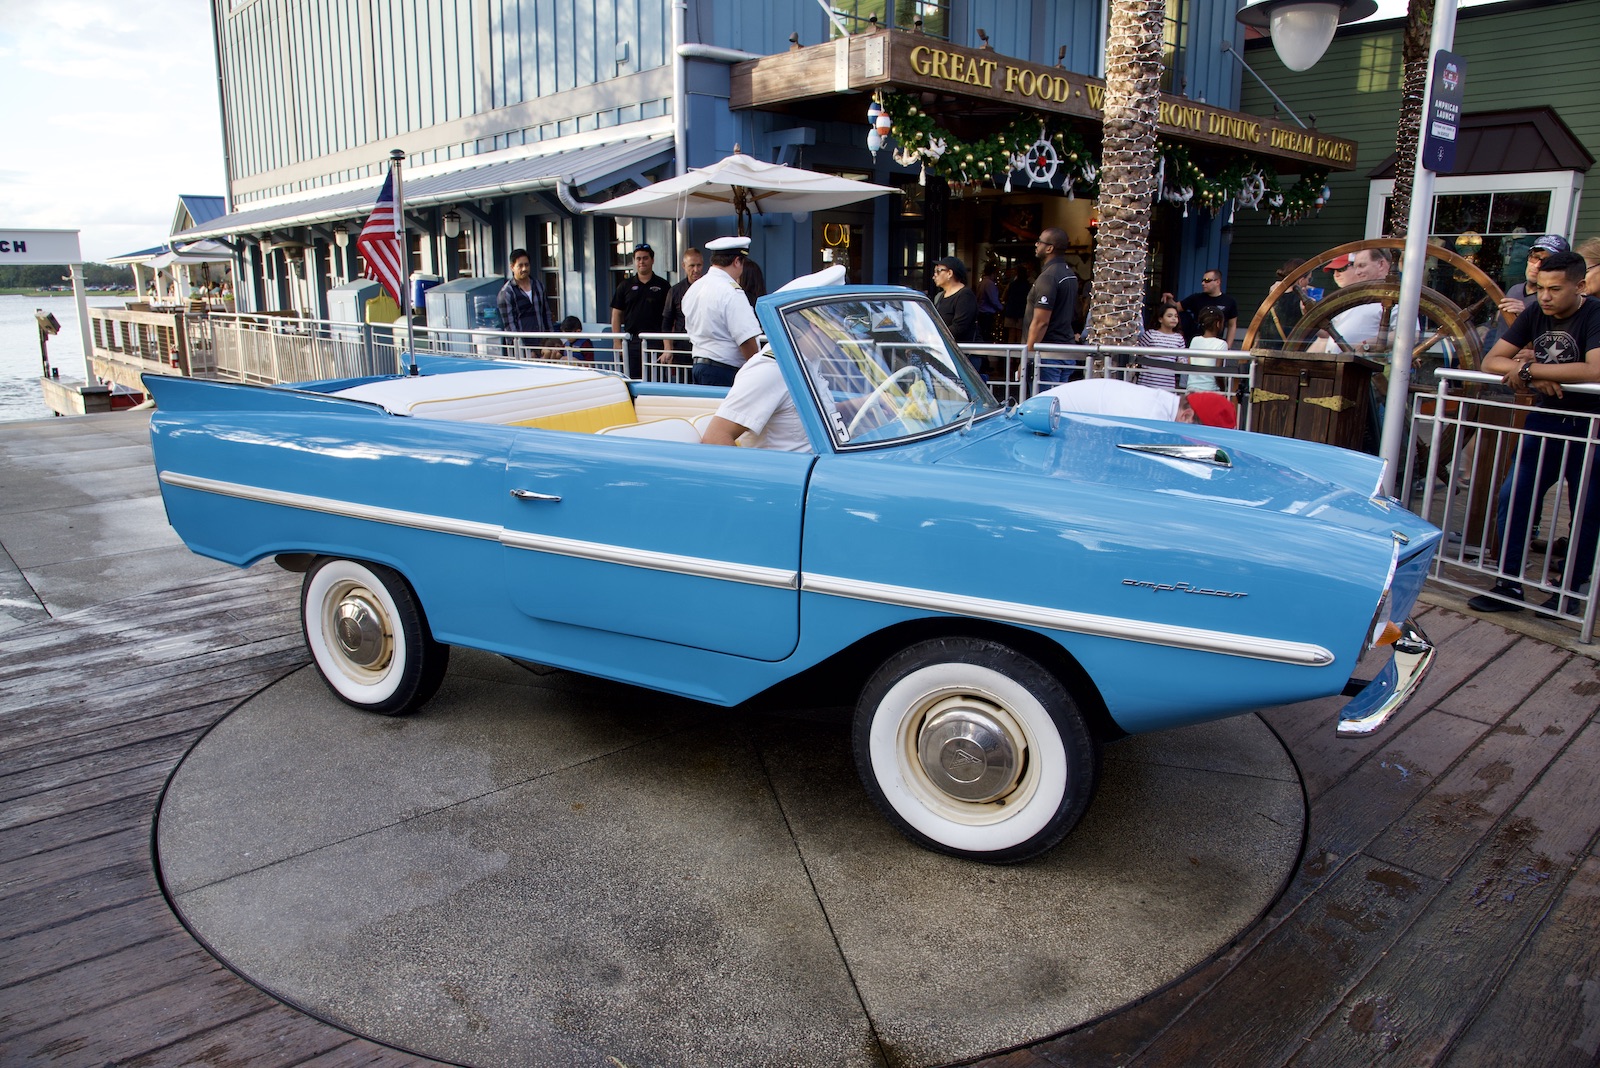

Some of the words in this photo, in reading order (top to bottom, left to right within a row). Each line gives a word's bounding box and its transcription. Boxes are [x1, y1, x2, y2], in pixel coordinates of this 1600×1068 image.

[910, 45, 998, 89] GREAT
[1005, 65, 1070, 103] FOOD
[1208, 112, 1262, 144] DINING
[1270, 127, 1315, 155] DREAM
[1316, 138, 1353, 163] BOATS
[1435, 99, 1459, 113] AMPHICAR
[1436, 109, 1456, 121] LAUNCH
[1539, 335, 1572, 350] CNVERSE
[830, 411, 851, 443] 5
